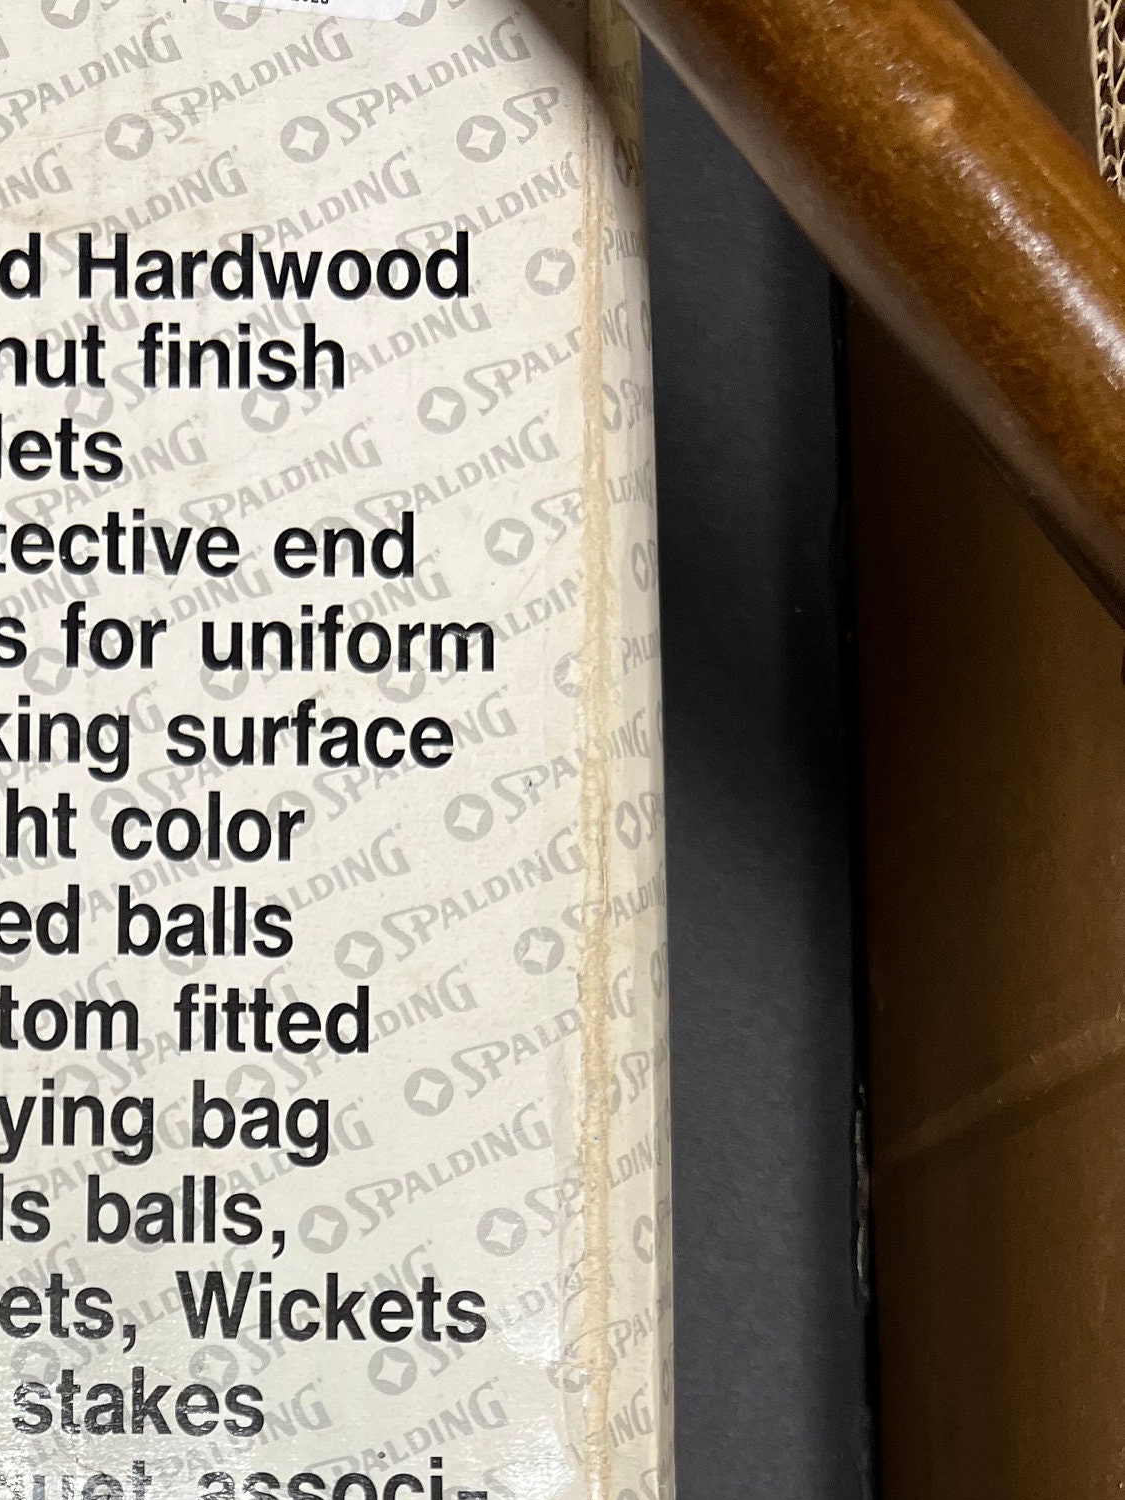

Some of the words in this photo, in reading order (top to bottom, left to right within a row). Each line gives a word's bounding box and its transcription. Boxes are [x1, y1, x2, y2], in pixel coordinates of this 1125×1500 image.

[152, 18, 350, 142] SPALDING
[328, 20, 526, 143] SPALDING
[78, 230, 469, 300] Hardwood
[138, 322, 345, 390] finish
[274, 511, 414, 578] end
[60, 600, 167, 669] for
[202, 604, 494, 673] uniform
[166, 698, 454, 768] surface
[111, 790, 305, 861] color
[117, 885, 293, 957] balls
[173, 983, 369, 1054] fitted
[192, 1079, 329, 1167] bag
[347, 1104, 549, 1235] SPALDING
[87, 1174, 285, 1259] balls,
[175, 1270, 487, 1343] Wickets
[11, 1366, 266, 1437] stakes
